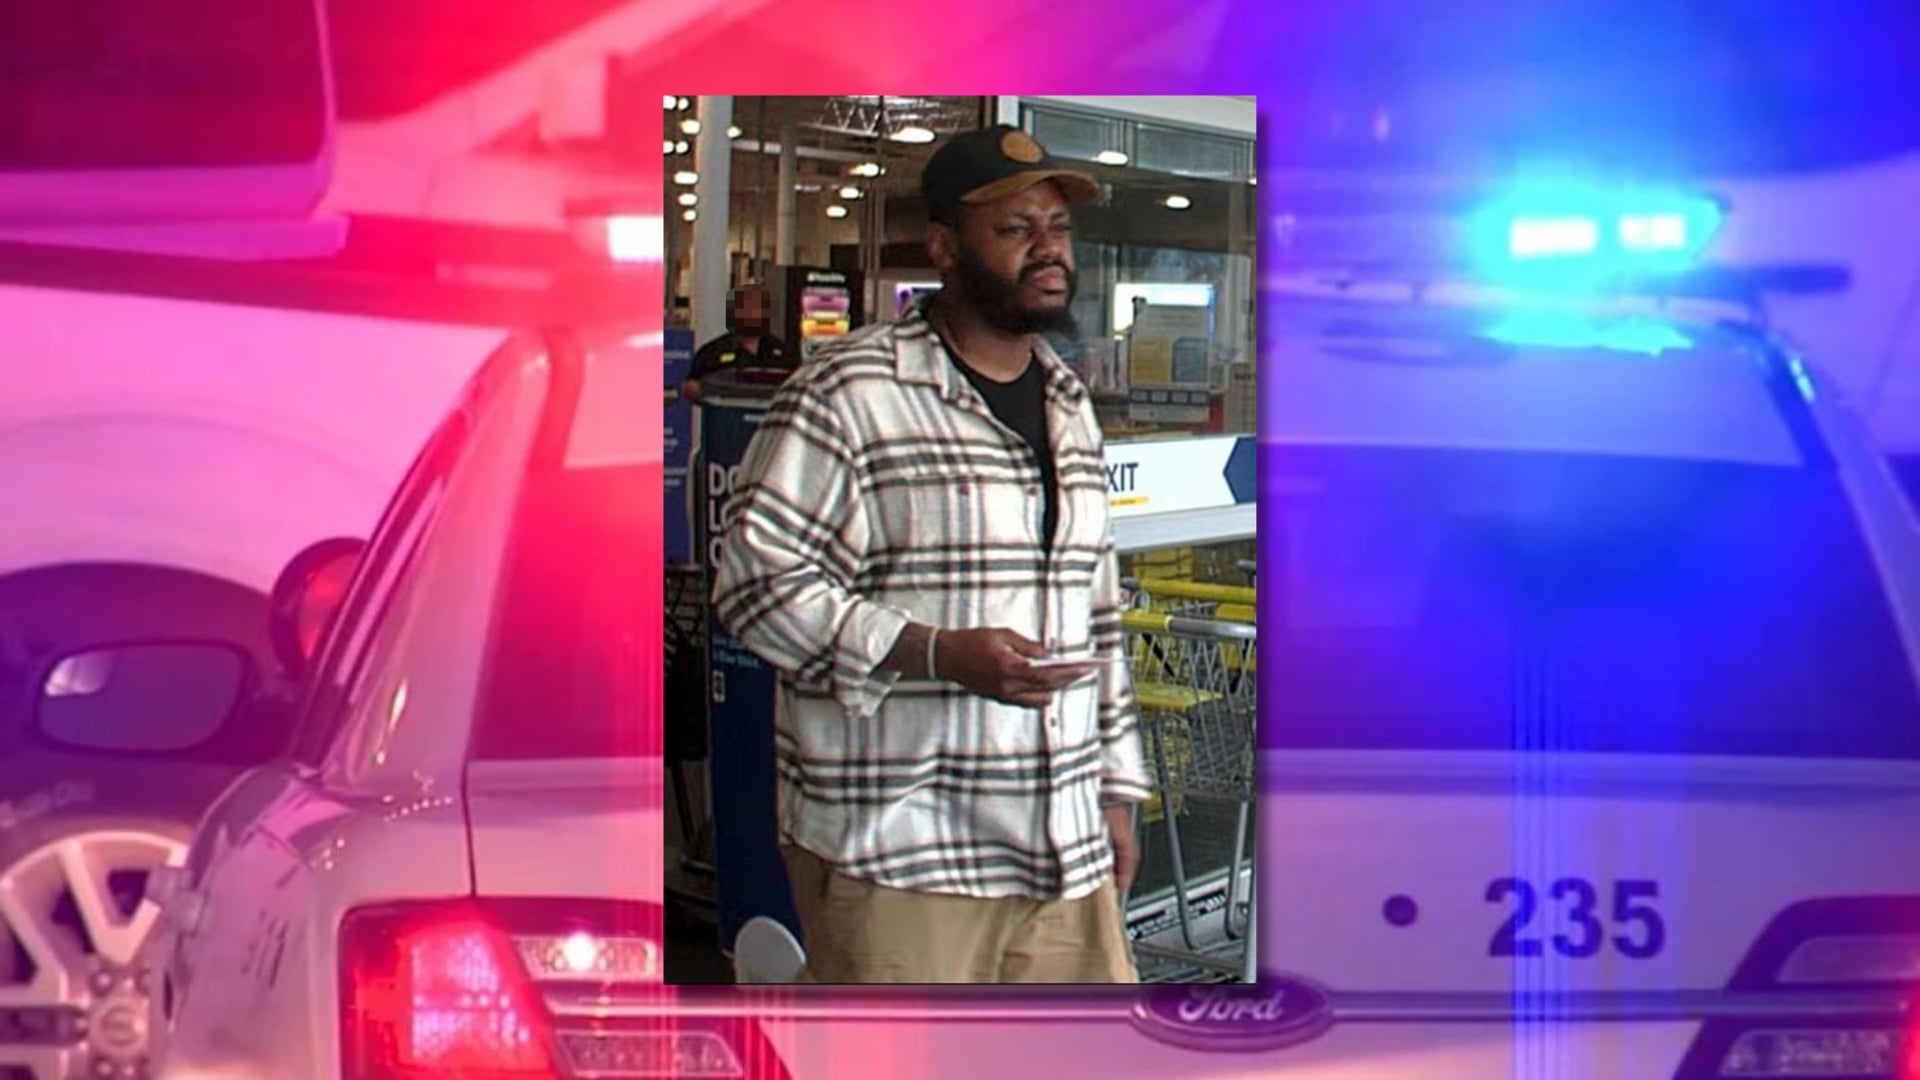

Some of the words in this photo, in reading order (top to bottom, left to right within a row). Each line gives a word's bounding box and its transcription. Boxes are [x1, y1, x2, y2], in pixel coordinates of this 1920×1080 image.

[1105, 462, 1139, 492] XIT
[1484, 877, 1666, 959] 235
[1178, 987, 1284, 1021] Ford
